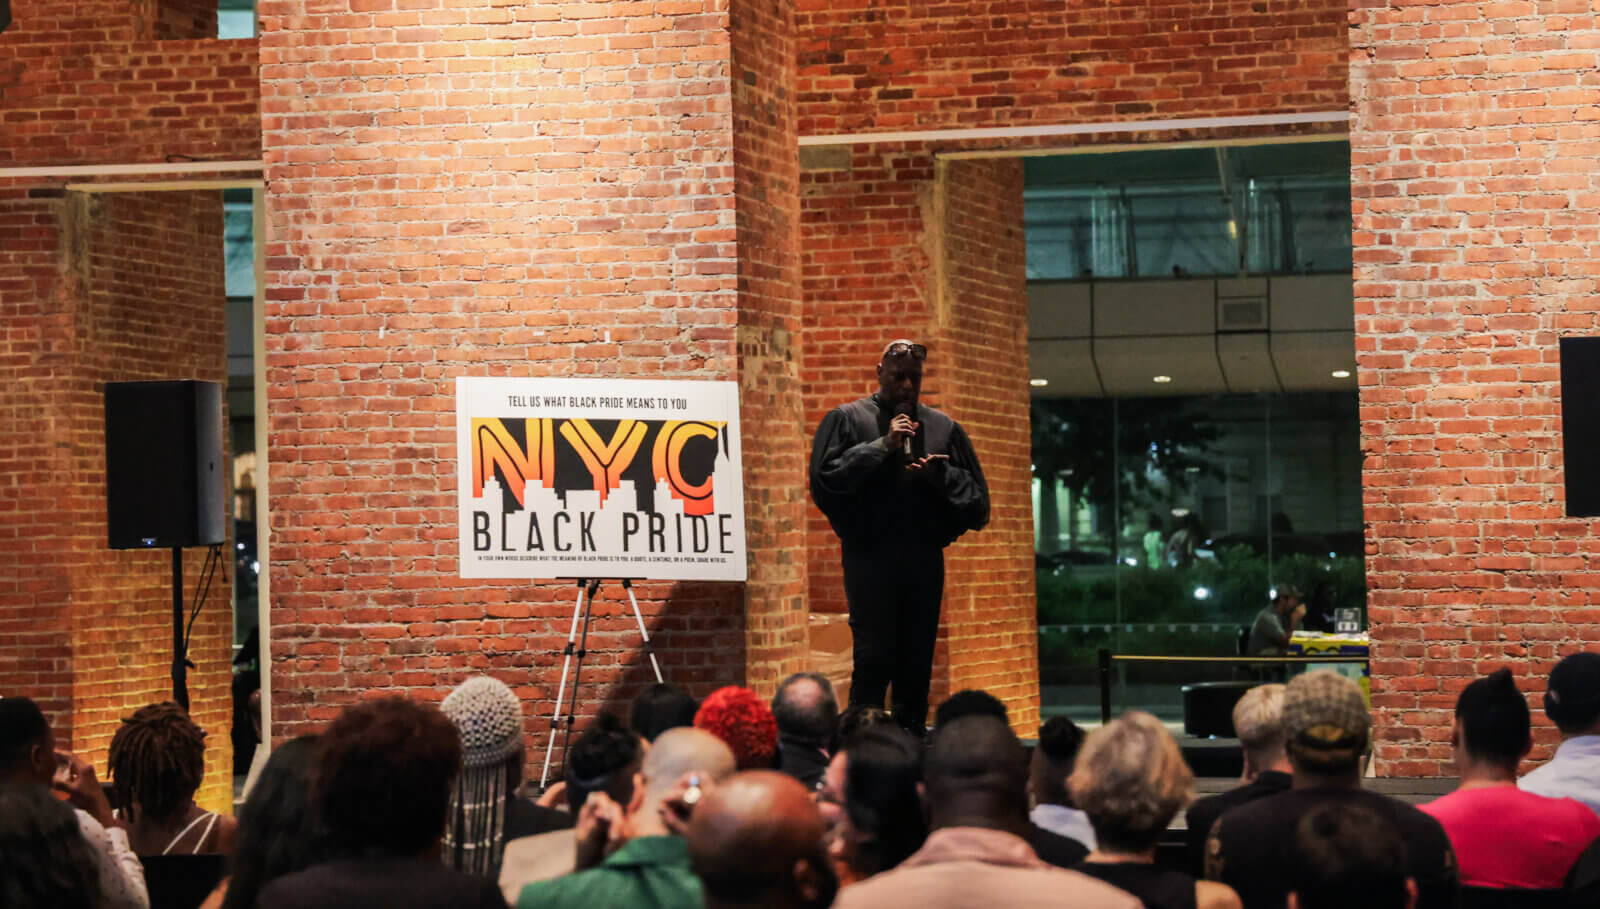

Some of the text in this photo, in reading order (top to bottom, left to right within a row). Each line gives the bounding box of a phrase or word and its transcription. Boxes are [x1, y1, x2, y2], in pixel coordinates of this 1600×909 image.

[508, 396, 687, 409] TELL US WHAT BLACK PRIDE MEANS TO YOU
[471, 417, 727, 516] NYC
[473, 511, 735, 554] BLACK PRIDE
